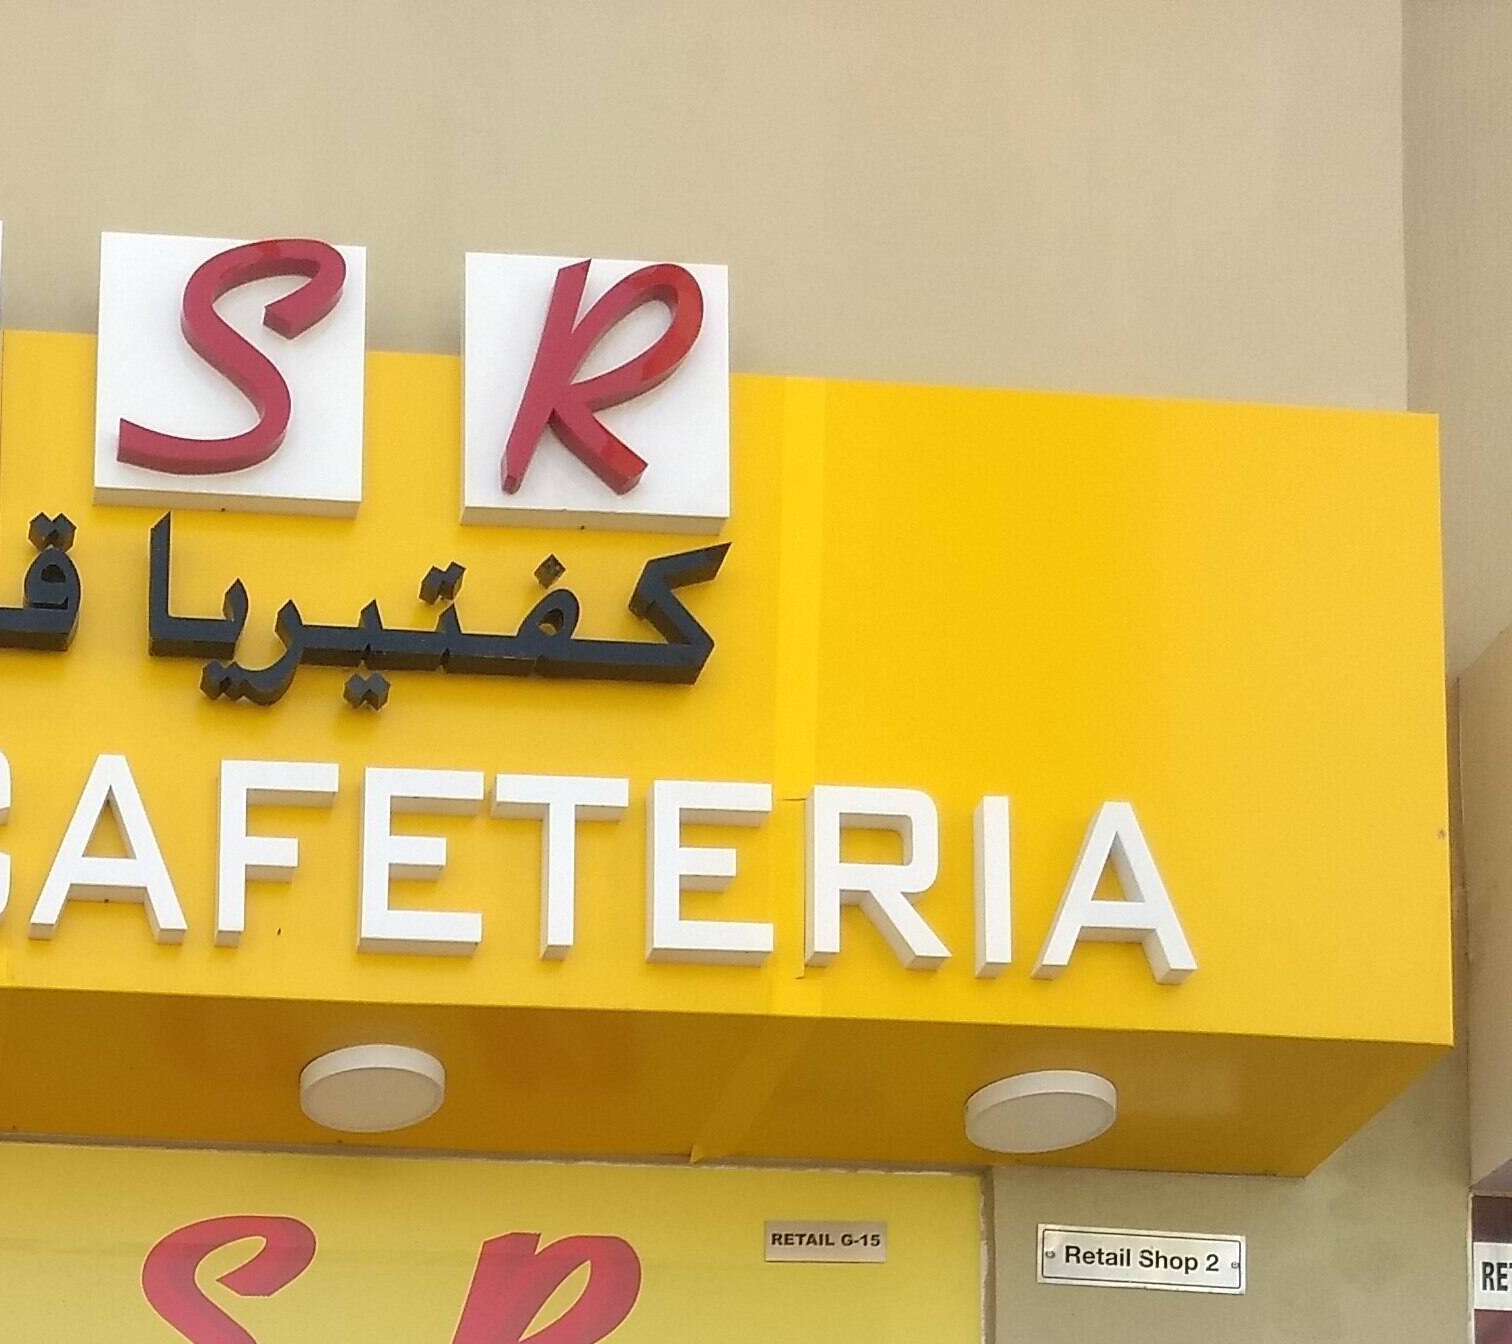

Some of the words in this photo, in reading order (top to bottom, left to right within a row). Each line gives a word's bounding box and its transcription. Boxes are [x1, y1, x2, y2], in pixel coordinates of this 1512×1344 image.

[148, 512, 732, 711] كفتيريا
[771, 1233, 835, 1246] RETAIL
[841, 1234, 880, 1246] G-15
[1065, 1245, 1131, 1267] Retail
[1139, 1249, 1198, 1274] Shop
[1206, 1254, 1219, 1271] 2
